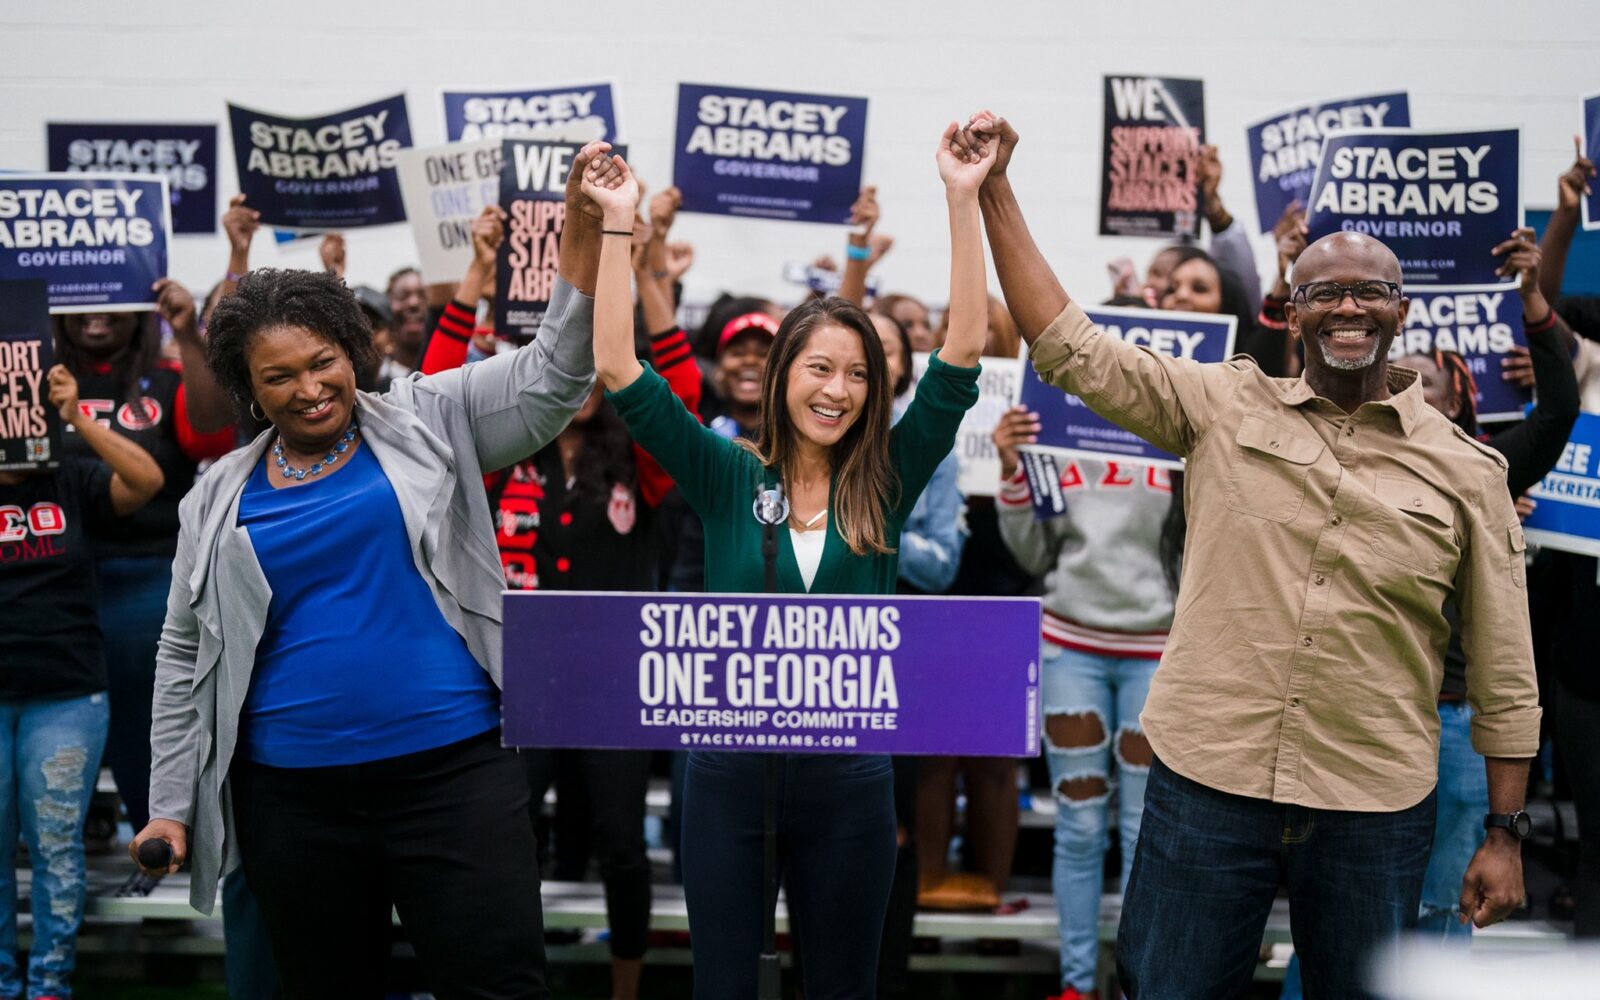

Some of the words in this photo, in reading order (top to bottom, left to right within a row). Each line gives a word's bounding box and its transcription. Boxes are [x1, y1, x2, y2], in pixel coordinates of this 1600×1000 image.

[464, 91, 597, 124] STACEY
[696, 95, 848, 134] STACEY
[1110, 77, 1166, 121] WE
[250, 110, 389, 153] STACEY
[686, 125, 852, 166] ABRAMS
[68, 138, 202, 166] STACEY
[247, 139, 402, 179] ABRAMS
[425, 152, 471, 187] ONE
[513, 144, 574, 191] WE
[1330, 145, 1492, 180] STACEY
[275, 176, 379, 195] GOVERNOR
[1315, 181, 1500, 216] ABRAMS
[0, 189, 143, 218] STACEY
[0, 218, 154, 248] ABRAMS
[1341, 220, 1463, 237] GOVERNOR
[18, 250, 126, 267] GOVERNOR
[1405, 292, 1505, 328] ACEY
[639, 603, 758, 649] STACEY
[762, 605, 901, 650] ABRAMS
[639, 651, 718, 706] ONE
[725, 652, 899, 709] GEORGIA
[640, 709, 769, 727] LEADERSHIP
[772, 711, 898, 730] COMMITTEE
[680, 733, 857, 747] STACEYABRAMS.COM
